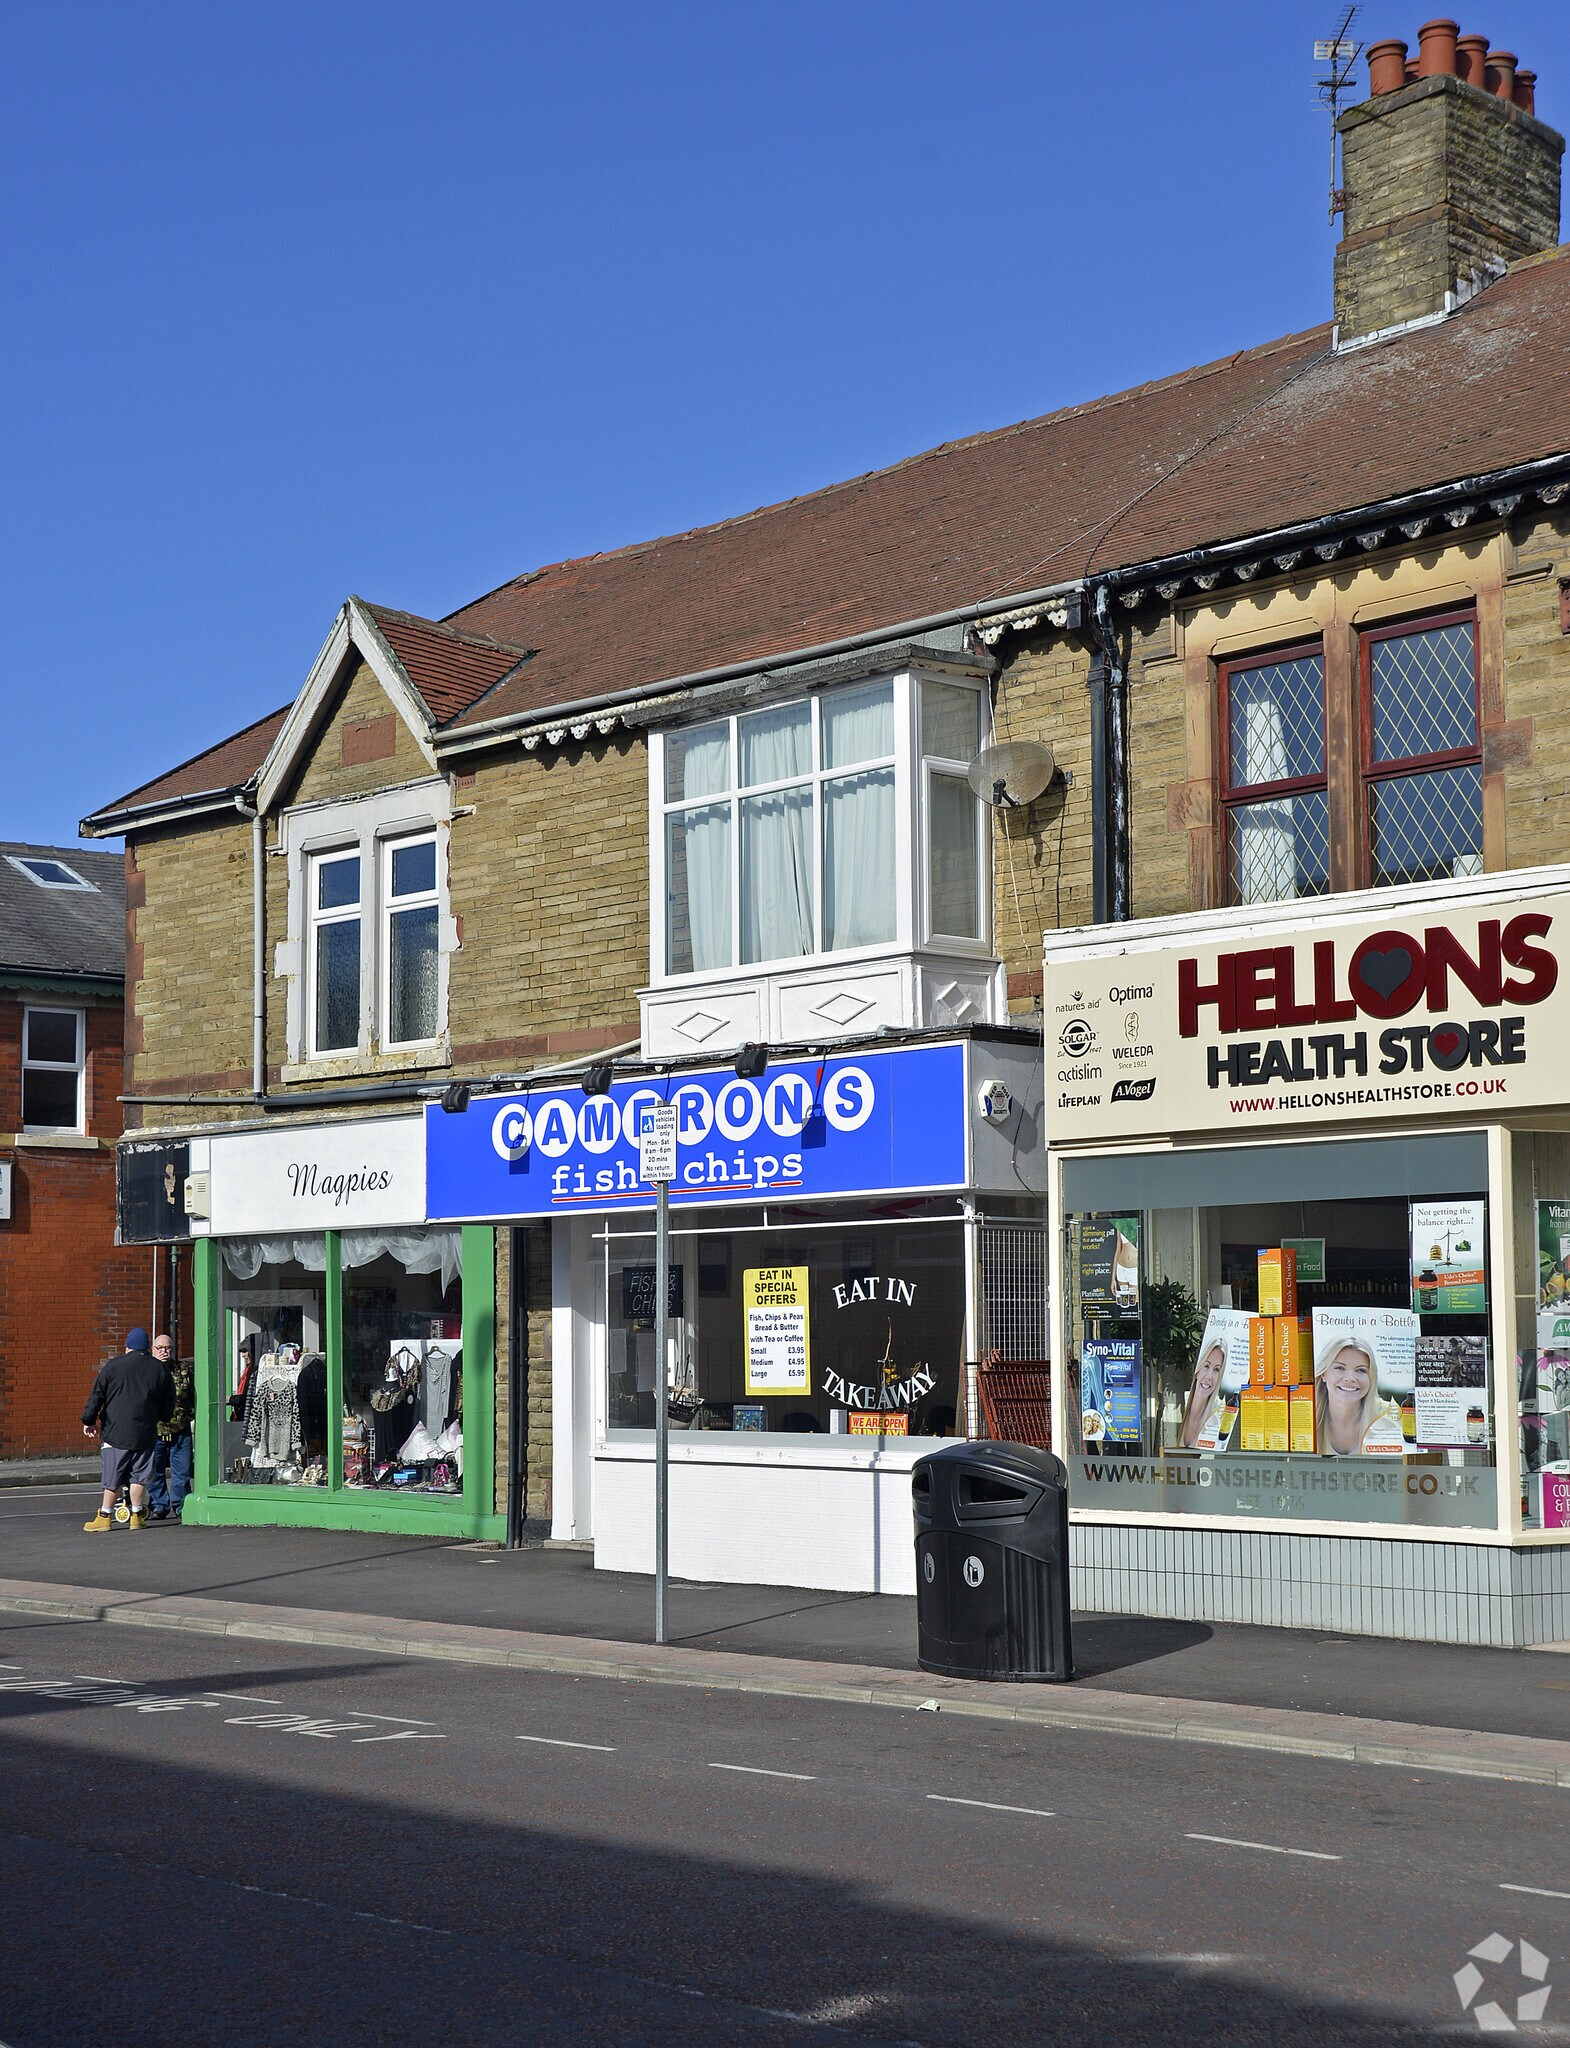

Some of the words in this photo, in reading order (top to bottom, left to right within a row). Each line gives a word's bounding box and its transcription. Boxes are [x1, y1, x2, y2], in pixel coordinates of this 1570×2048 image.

[1178, 913, 1558, 1038] HELLONS
[1109, 985, 1153, 1005] Optima
[1056, 1001, 1085, 1013] natures
[1087, 1000, 1100, 1009] aid
[1058, 1032, 1097, 1044] SOLGAR
[1112, 1045, 1154, 1059] WELEDA
[1207, 1031, 1368, 1088] HEALTH
[1378, 1016, 1526, 1075] STORE
[1057, 1063, 1102, 1082] actislim
[1114, 1083, 1151, 1097] A.Vogel
[1229, 1078, 1507, 1114] WWW.HELLONSHEALTHSTORE.CO.UK
[551, 1160, 639, 1195] fish
[684, 1149, 803, 1188] chips
[287, 1163, 393, 1206] Magpies
[1417, 1208, 1431, 1216] Not
[1433, 1207, 1458, 1216] getting
[1459, 1206, 1471, 1215] the
[1417, 1218, 1445, 1226] balance
[1106, 1229, 1115, 1238] pill
[1303, 1262, 1320, 1271] Food
[759, 1270, 778, 1280] EAT
[782, 1270, 792, 1280] IN
[754, 1282, 798, 1292] SPECIAL
[832, 1276, 880, 1309] EAT
[886, 1277, 917, 1307] IN
[756, 1294, 796, 1304] OFFERS
[749, 1314, 764, 1322] Fish,
[764, 1313, 782, 1322] Chips
[1315, 1313, 1355, 1329] Beauty
[1358, 1316, 1367, 1326] in
[1380, 1314, 1417, 1328] Bottle
[1256, 1325, 1264, 1356] Choice
[1281, 1325, 1290, 1356] Choice
[1086, 1342, 1135, 1358] Syno-Vital
[750, 1370, 768, 1378] Large
[1256, 1358, 1265, 1382] Udo's
[1282, 1358, 1290, 1383] Udo's
[821, 1362, 936, 1410] TAKEAWAY
[852, 1417, 864, 1426] WE
[866, 1418, 882, 1427] ARE
[884, 1418, 904, 1428] OPEN
[1555, 1500, 1564, 1512] &
